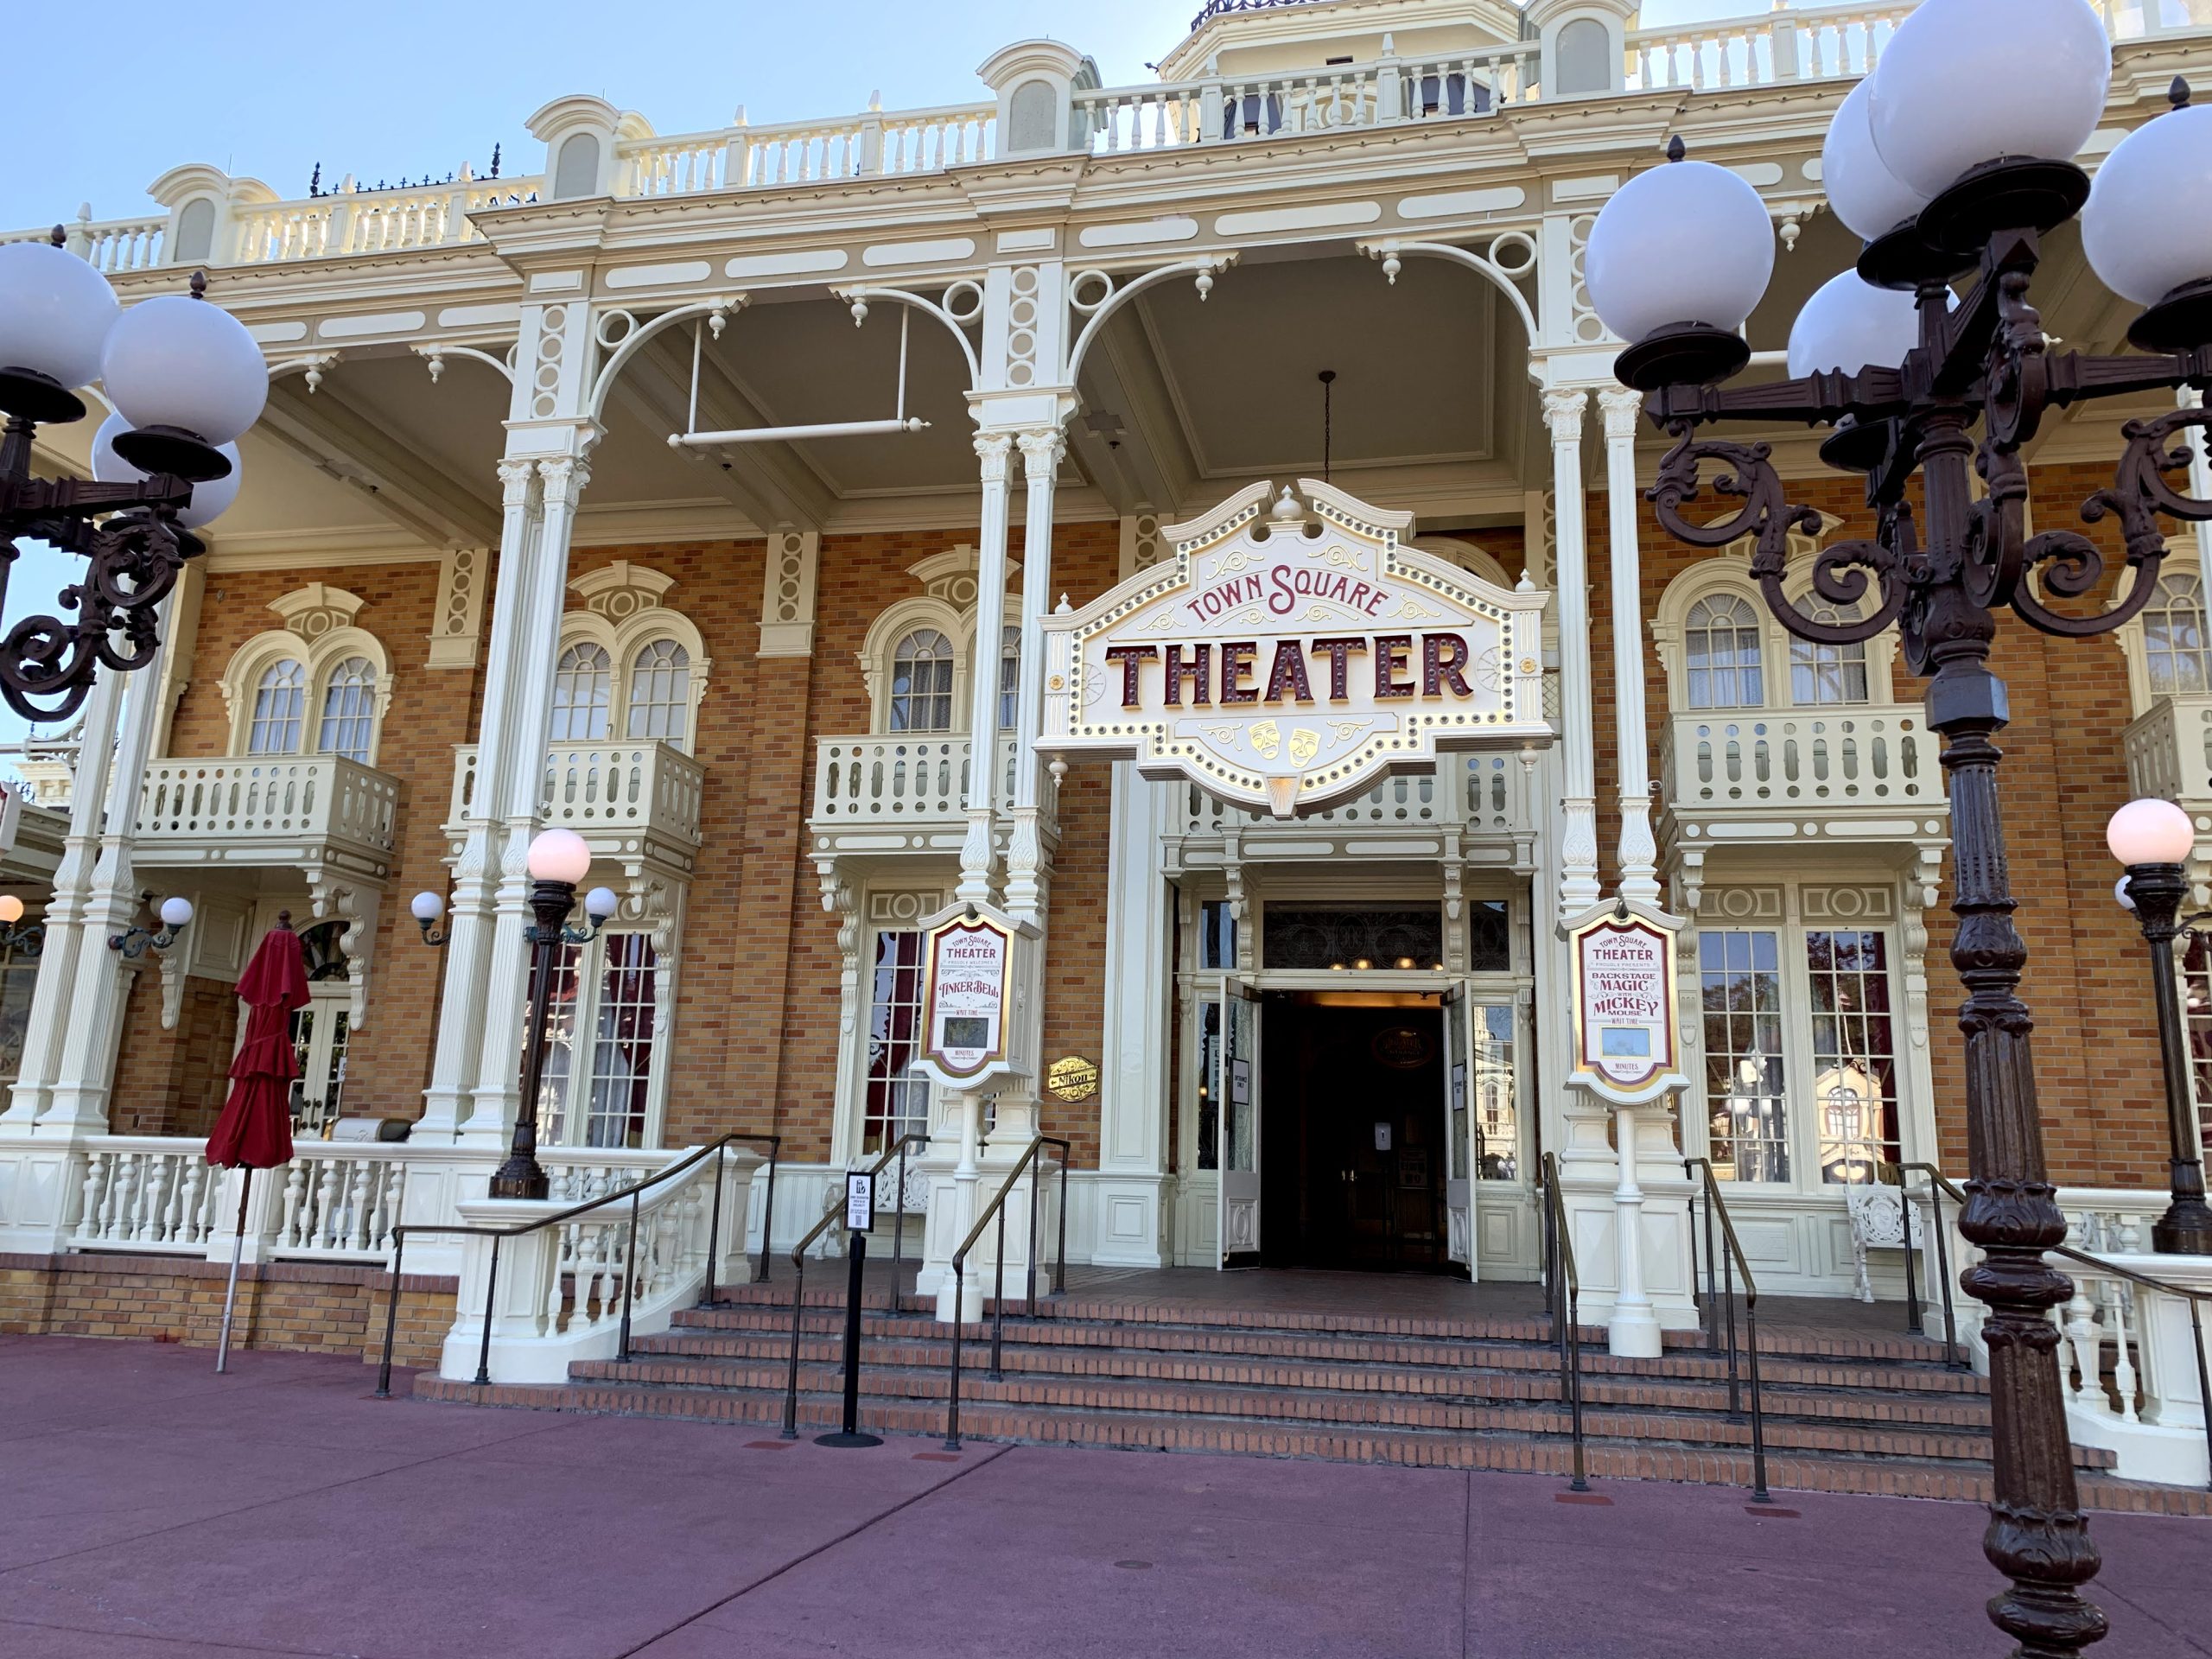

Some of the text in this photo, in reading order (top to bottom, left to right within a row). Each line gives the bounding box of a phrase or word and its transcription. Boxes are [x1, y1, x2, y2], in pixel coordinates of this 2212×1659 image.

[1186, 564, 1389, 623] TOWN SQUARE
[1105, 632, 1474, 709] THEATER
[952, 935, 991, 948] TOWN SQUARE
[1599, 935, 1647, 949] TOWN SQUARE
[946, 948, 996, 958] THEATER
[1592, 949, 1654, 960] THEATER
[1599, 979, 1649, 991] MAGIC
[1593, 996, 1659, 1016] MICKEY
[1058, 1074, 1088, 1084] Nikon
